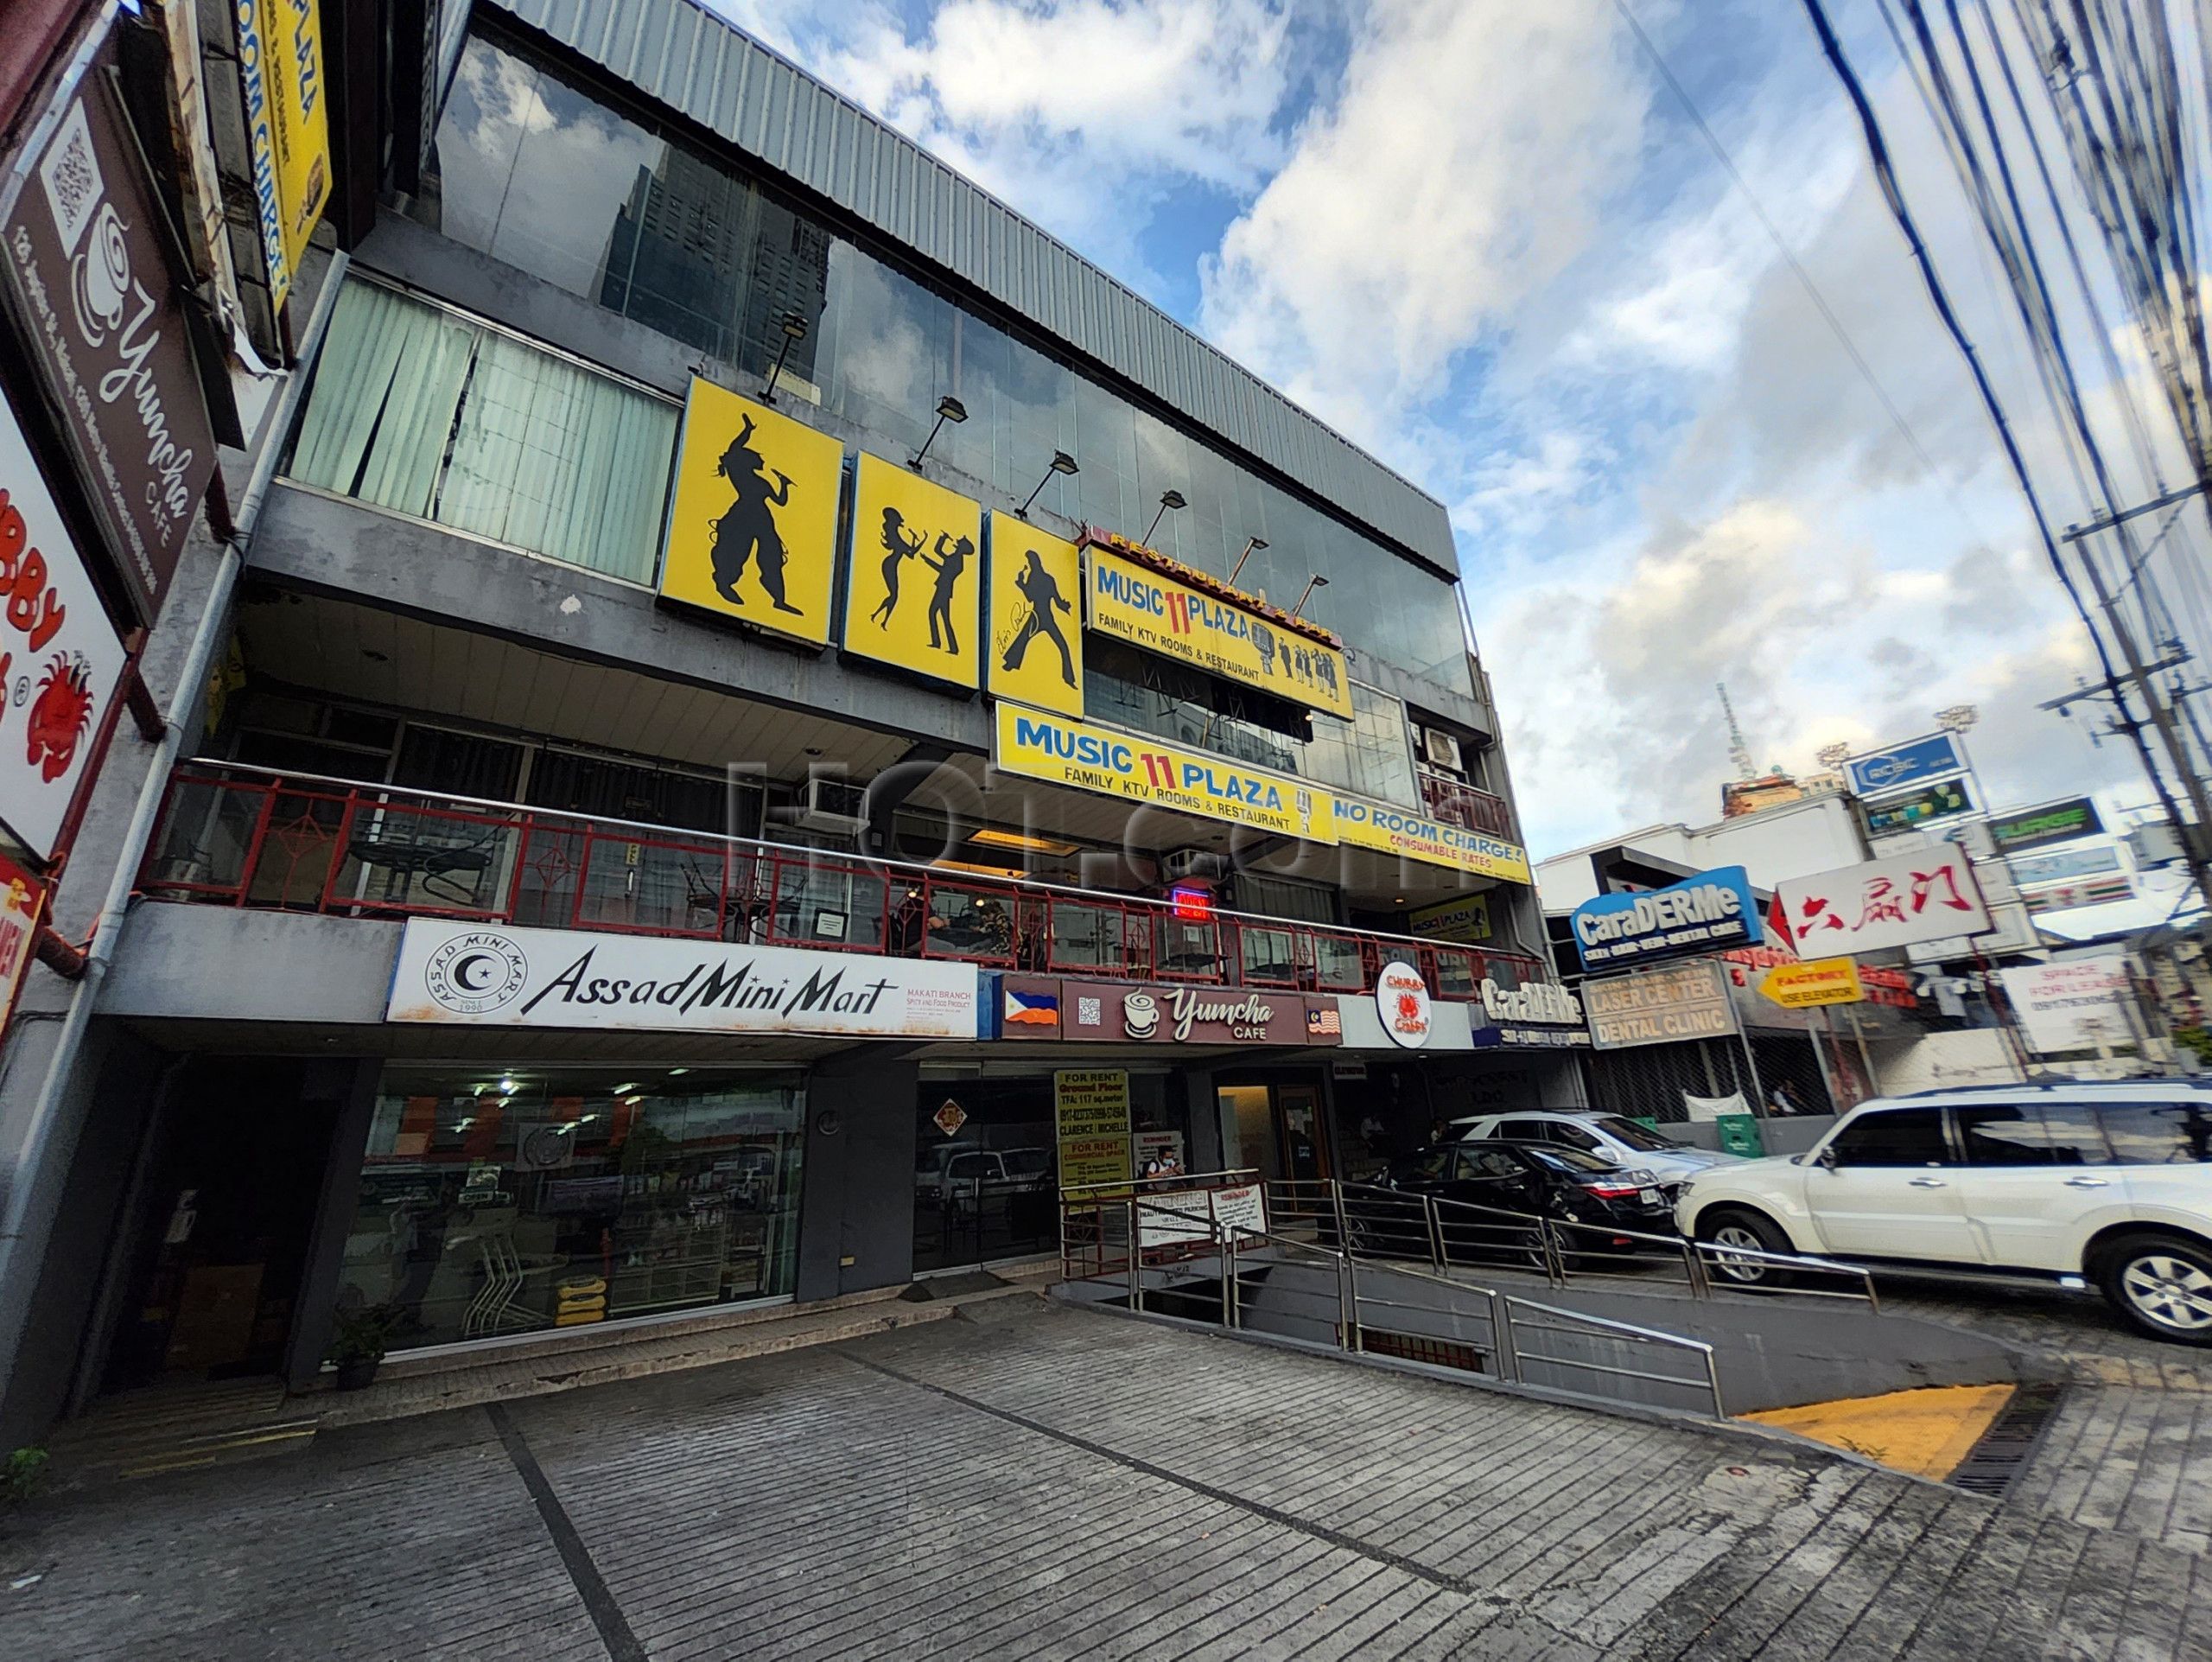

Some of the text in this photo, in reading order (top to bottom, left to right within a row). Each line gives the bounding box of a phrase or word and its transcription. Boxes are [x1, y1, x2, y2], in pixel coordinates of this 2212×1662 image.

[252, 122, 288, 296] CHARGE!
[99, 277, 194, 519] Yumcha
[145, 481, 172, 548] CAFE
[0, 488, 67, 653] BBY
[1110, 532, 1267, 610] RESTAURANT
[1294, 616, 1332, 642] BAR
[1097, 565, 1251, 642] MUSIC 11 PLAZA
[1098, 613, 1260, 682] FAMILY KTV ROOMS & RESTAURANT
[1016, 717, 1283, 812] MUSIC 11 PLAZA
[1064, 767, 1291, 831] FAMILY KTV ROOMS & RESTAURANT
[1333, 799, 1523, 863] NO ROOM CHARGE!
[1389, 834, 1458, 859] CONSUMABLE
[1461, 851, 1492, 869] RATES
[1413, 917, 1438, 932] MUSIC
[1445, 910, 1471, 924] PLAZA
[1576, 884, 1741, 946] CaraDERMe
[430, 934, 523, 1004] ASSAD MINI MART
[519, 943, 899, 1020] Assad Mini Mart
[1387, 975, 1425, 990] CHUBBY
[2039, 964, 2101, 980] SPACE
[907, 989, 971, 1000] MAKATI BRANCH
[1591, 977, 1717, 1013] LASER CENTER
[2029, 984, 2066, 997] FOR
[1159, 987, 1274, 1041] Yumcha
[1596, 1016, 1662, 1042] DENTAL
[1663, 1009, 1726, 1035] CLINIC
[1233, 1026, 1267, 1040] CAFE
[1059, 1082, 1123, 1093] Ground Floor
[1065, 1073, 1118, 1082] FOR RENT
[1061, 1095, 1077, 1105] TFA:
[1080, 1094, 1091, 1104] 117
[1059, 1122, 1128, 1136] CLARENCE MICHELLE
[1072, 1141, 1119, 1153] FOR RENT
[1185, 1205, 1209, 1213] PARKING
